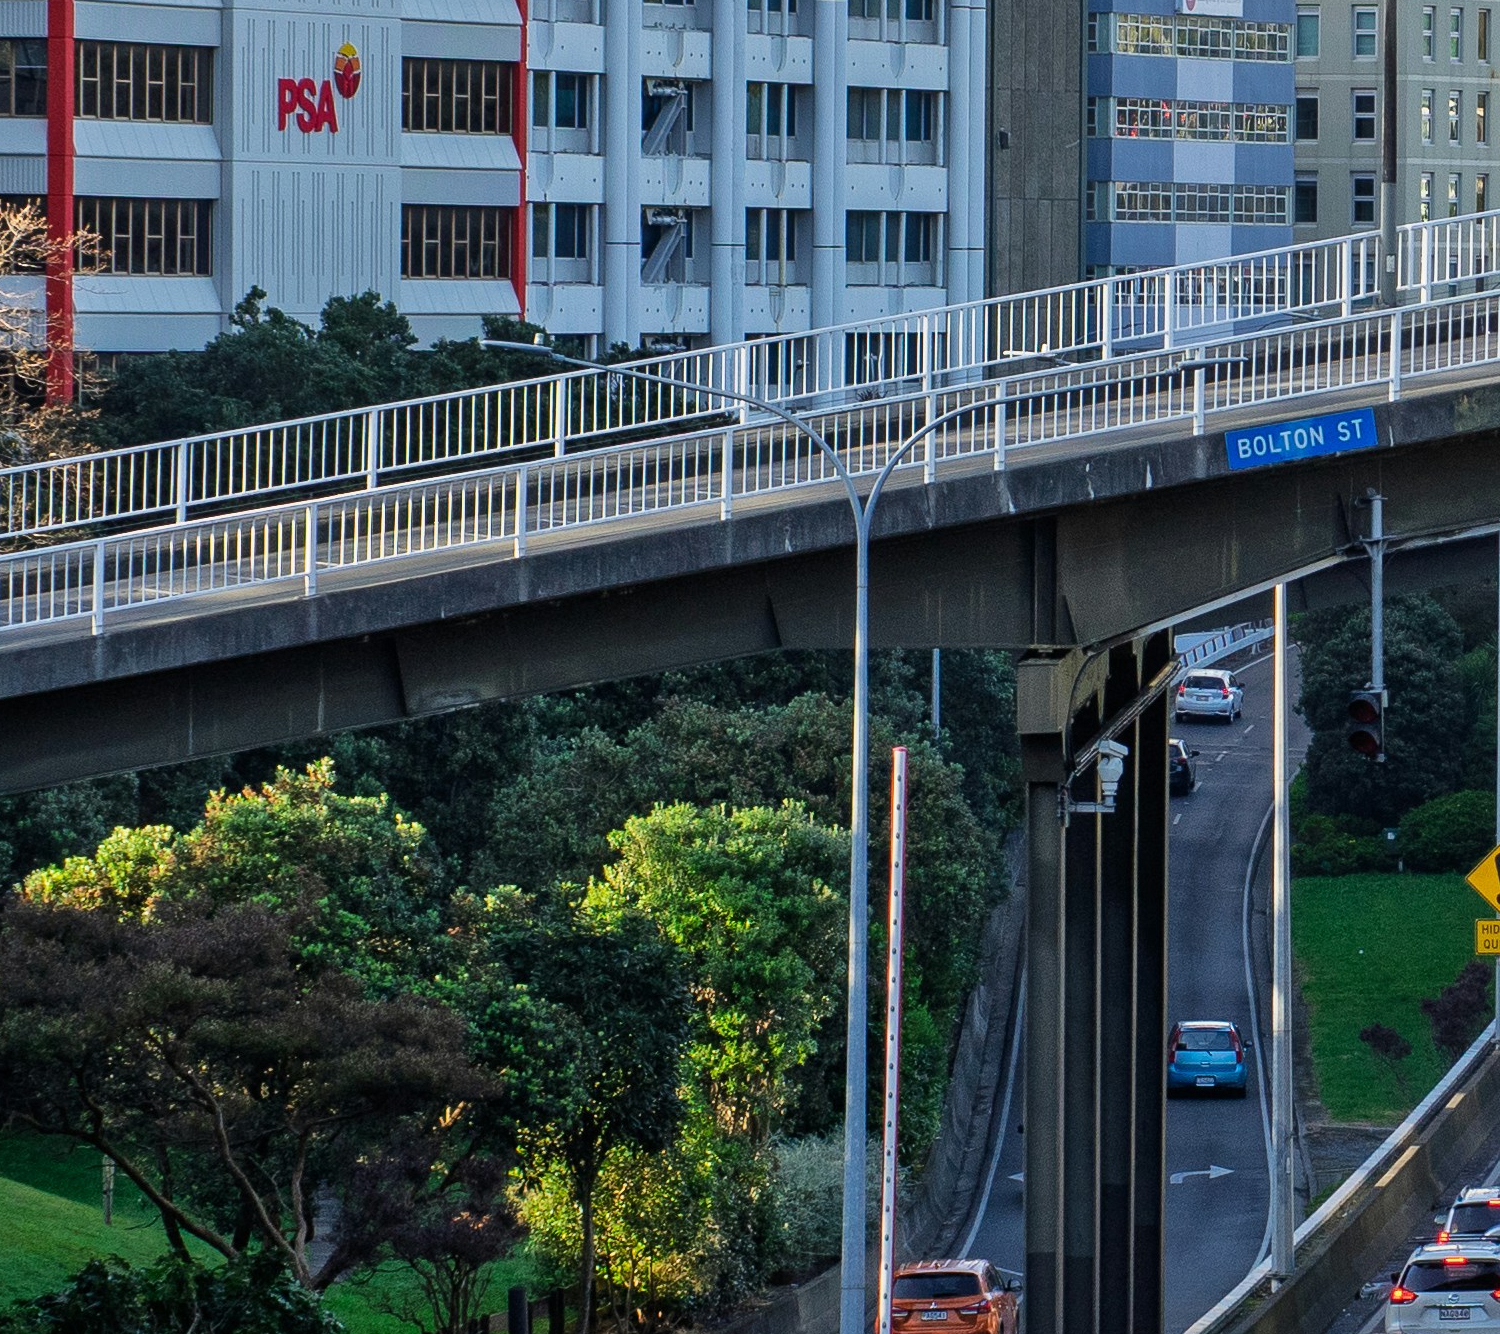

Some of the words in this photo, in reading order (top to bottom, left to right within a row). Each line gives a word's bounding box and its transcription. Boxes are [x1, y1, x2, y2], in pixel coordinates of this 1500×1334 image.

[278, 78, 338, 133] PSA
[1238, 427, 1331, 459] BOLTON
[1337, 419, 1363, 443] ST
